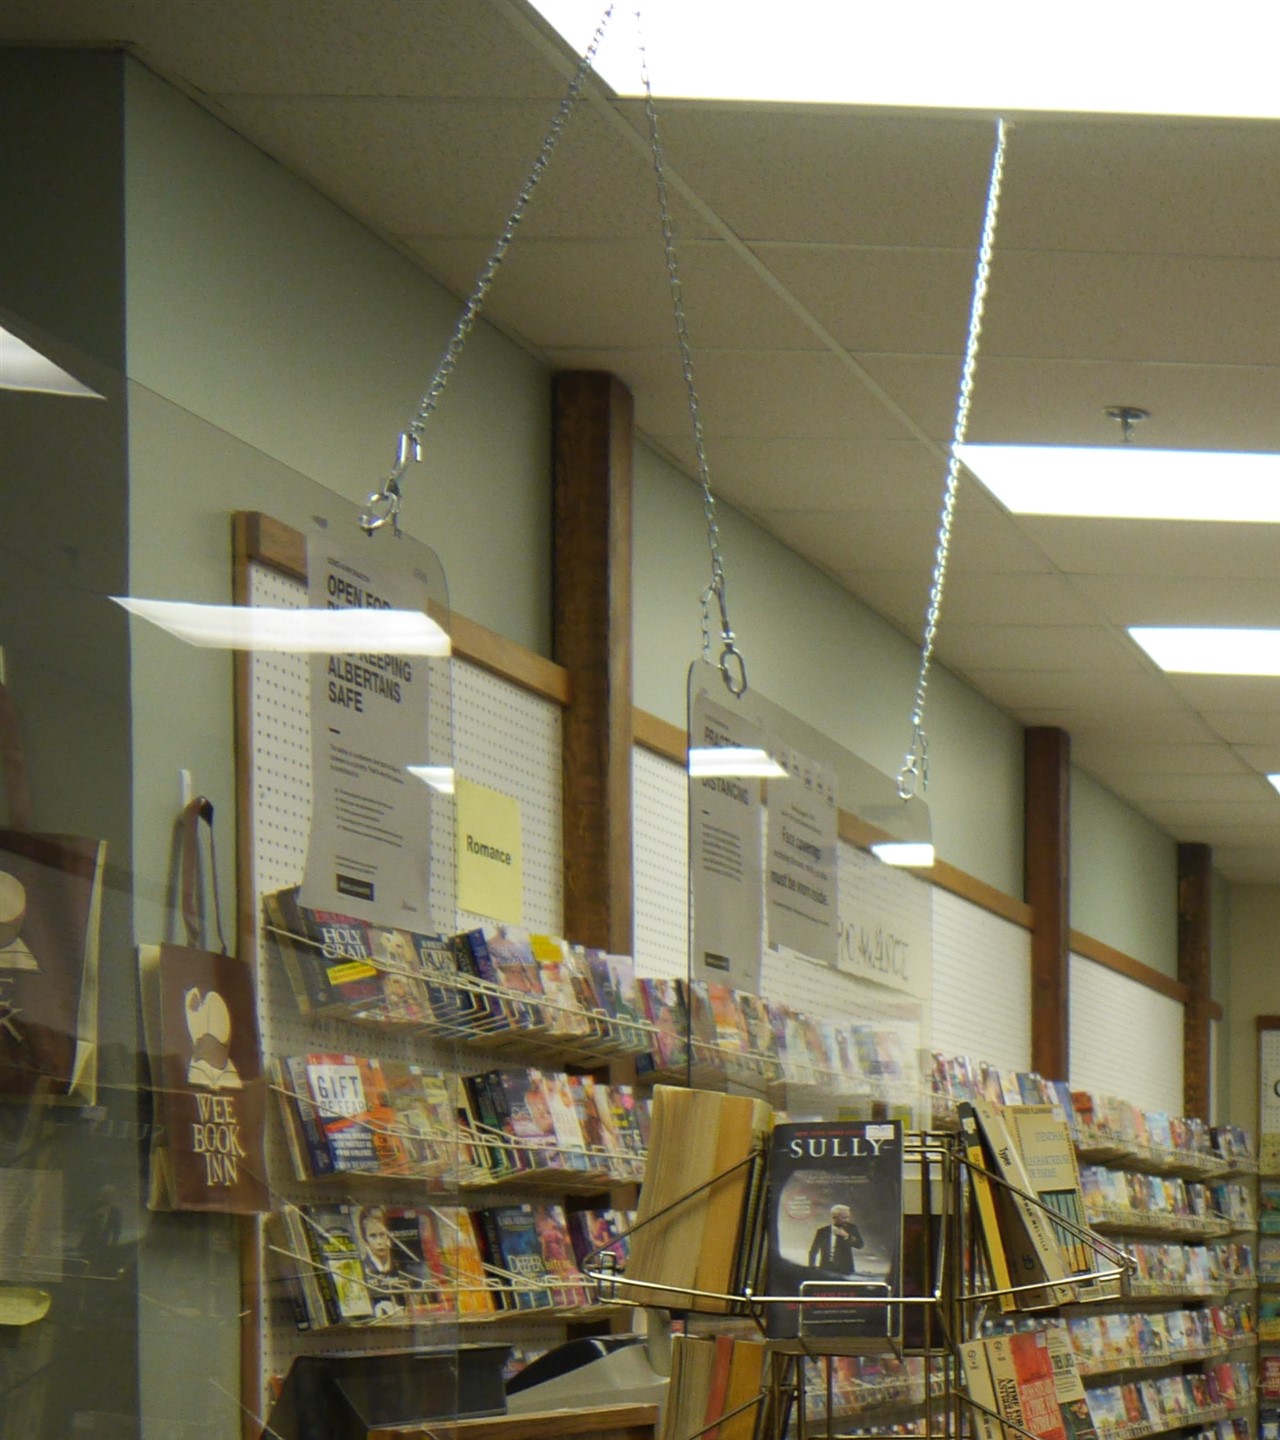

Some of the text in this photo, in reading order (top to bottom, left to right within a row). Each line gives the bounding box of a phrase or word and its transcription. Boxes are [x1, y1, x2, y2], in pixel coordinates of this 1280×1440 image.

[327, 574, 363, 606] OPEN
[327, 656, 402, 704] ALBERTANS
[327, 681, 363, 713] SAFE
[466, 834, 512, 866] Romance
[322, 927, 362, 945] HOLY
[317, 1075, 358, 1099] GIFT
[197, 1094, 237, 1124] WEE
[193, 1124, 246, 1158] BOOK
[790, 1138, 885, 1159] SULLY
[1000, 1146, 1012, 1168] Typee
[204, 1152, 238, 1186] INN
